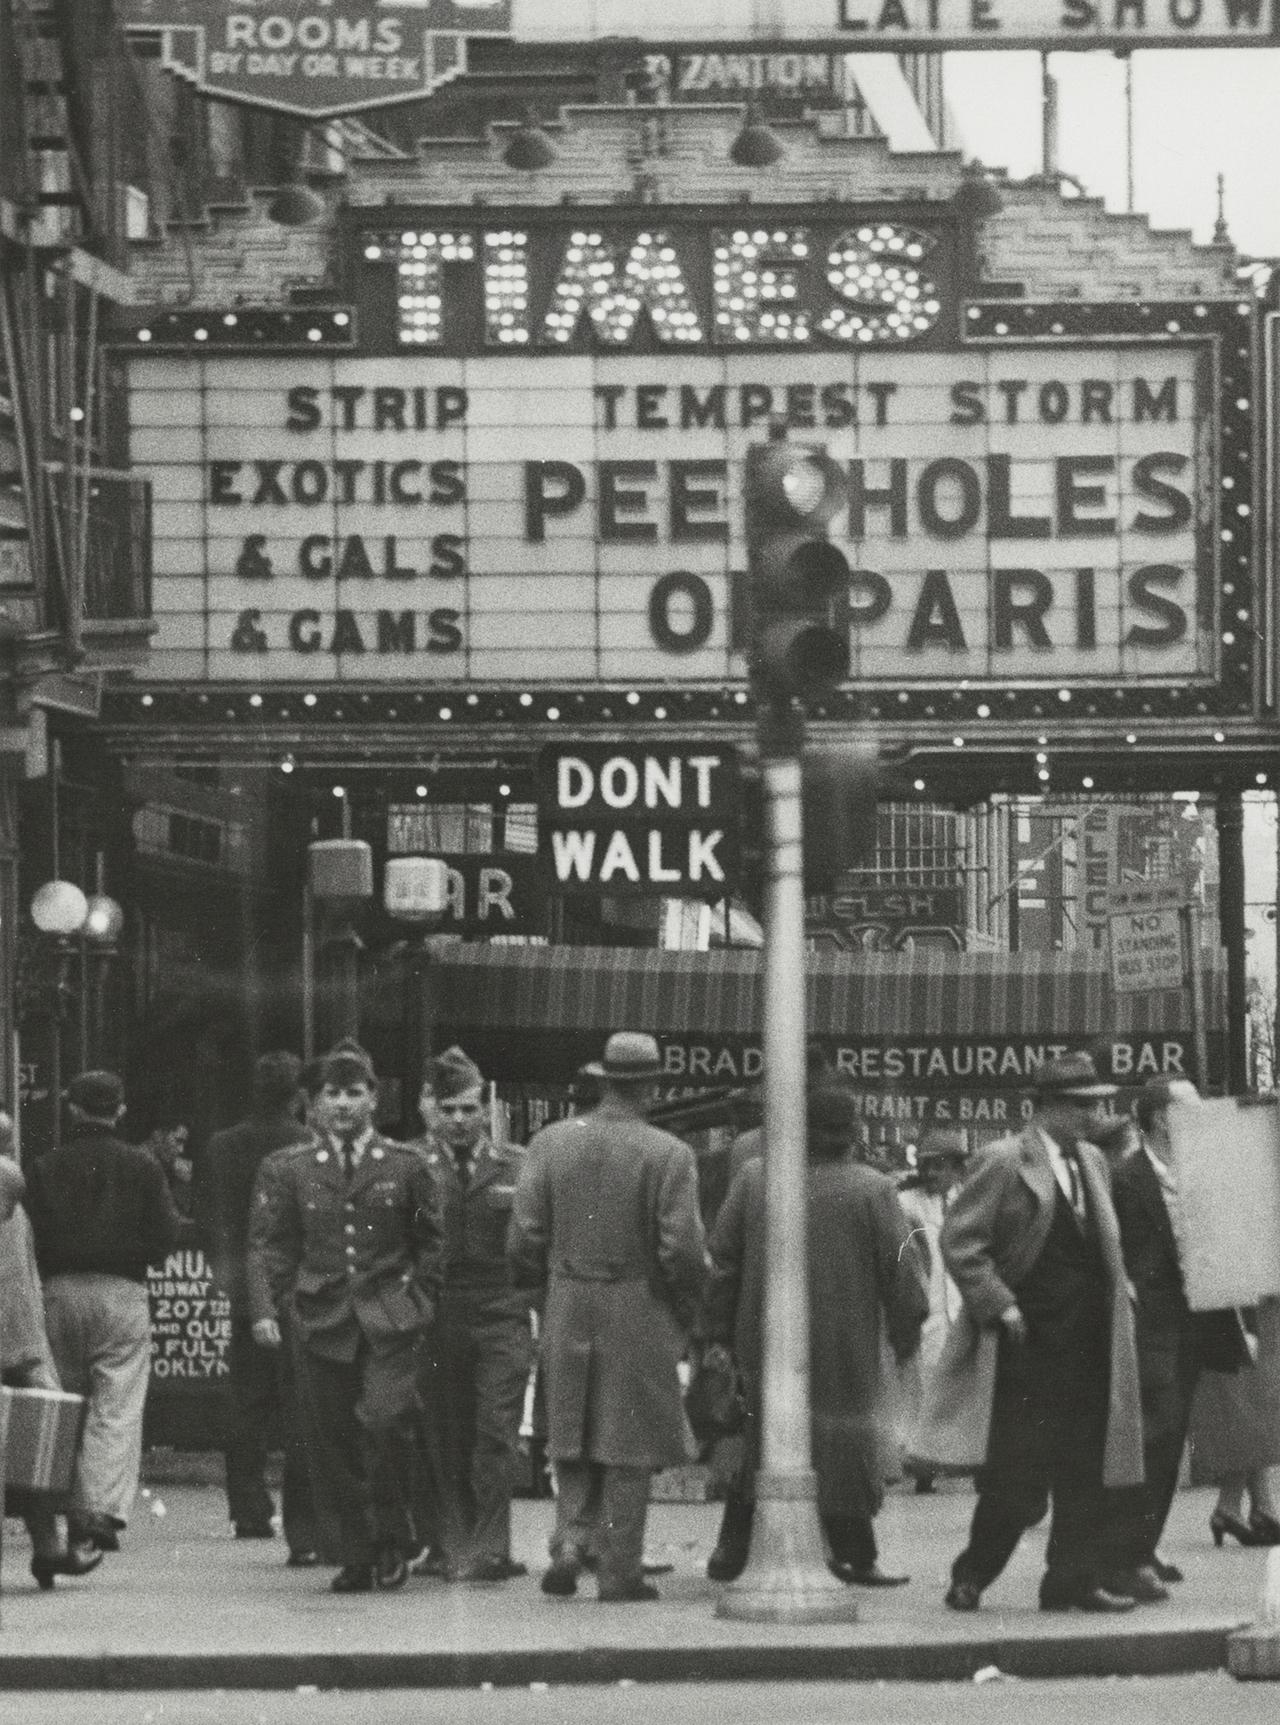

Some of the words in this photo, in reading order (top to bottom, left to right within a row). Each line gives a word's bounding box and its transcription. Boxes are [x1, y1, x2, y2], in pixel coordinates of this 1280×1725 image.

[226, 15, 402, 52] ROOMS
[210, 51, 243, 74] BY
[247, 53, 298, 76] DAY
[302, 54, 339, 77] OR
[344, 56, 420, 80] WEEK
[362, 222, 944, 346] TIMES
[286, 386, 469, 432] STRIP
[594, 382, 898, 431] TEMPEST
[950, 376, 1178, 425] STORM
[210, 460, 468, 506] EXOTICS
[524, 459, 729, 543] PEE
[235, 534, 273, 580] &
[299, 534, 467, 580] GALS
[231, 608, 268, 654] &
[288, 608, 464, 654] GAMS
[834, 562, 1191, 656] PARIS
[557, 756, 721, 810] DONT
[552, 829, 726, 883] WALK
[448, 867, 515, 920] AR
[1131, 915, 1161, 932] NO
[837, 1045, 1067, 1078] RESTAURANT
[1111, 1042, 1185, 1074] BAR
[959, 1097, 1008, 1120] BAR
